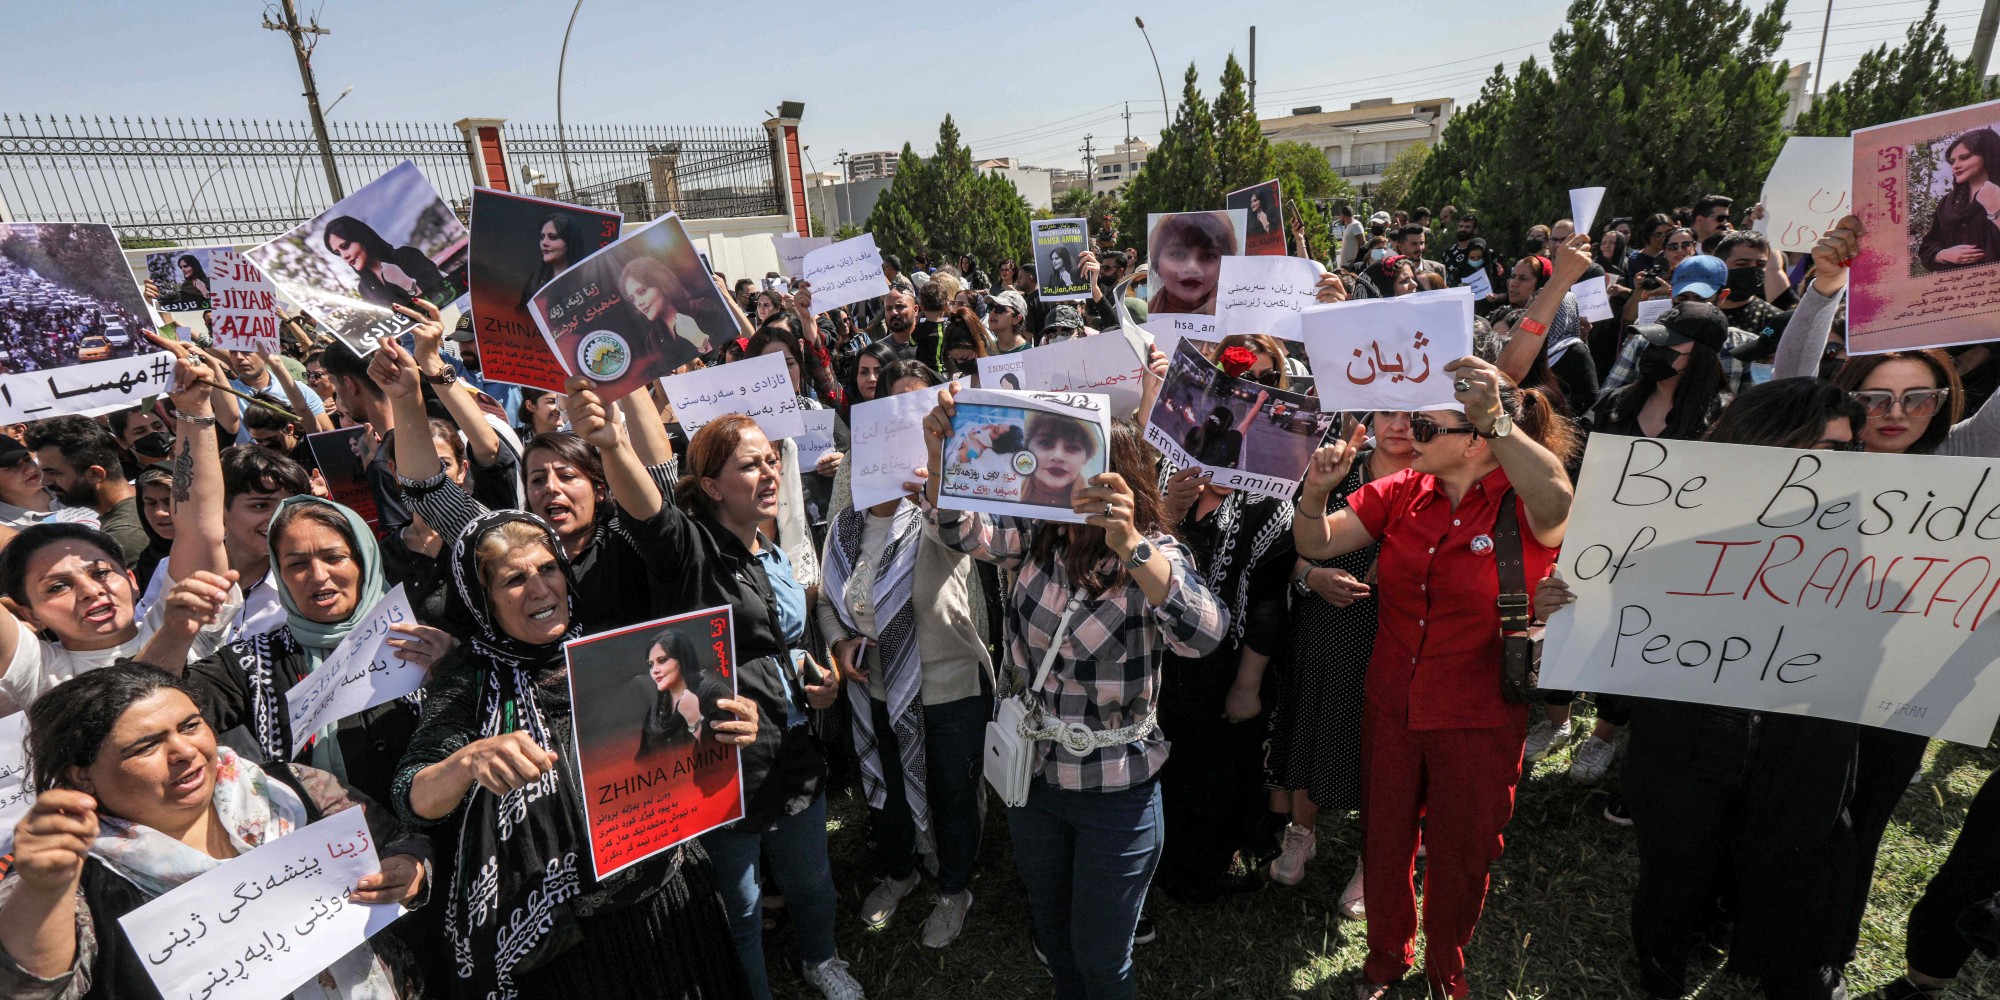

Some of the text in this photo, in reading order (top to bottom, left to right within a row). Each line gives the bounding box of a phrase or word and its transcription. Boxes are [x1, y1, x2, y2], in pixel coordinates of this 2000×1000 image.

[1038, 235, 1083, 246] MAHSA AMINI!
[160, 301, 198, 312] ئازادی
[811, 282, 836, 295] ژێردەست
[360, 312, 410, 347] ئازادی
[1346, 330, 1430, 386] ژیان
[676, 373, 787, 410] ئازادی و سەربەستی
[778, 397, 796, 414] ئیتر
[745, 406, 774, 418] بەسە
[1611, 438, 1708, 510] Be
[1573, 525, 1658, 585] of
[1610, 604, 1822, 684] People
[294, 660, 341, 720] ئازادی
[341, 659, 388, 688] بەسە
[1875, 699, 1929, 719] #IRAN
[598, 743, 729, 805] ZHINA AMINI
[148, 830, 370, 966] ژینا پێشەنگی ژینی
[294, 884, 353, 937] ەوێنی
